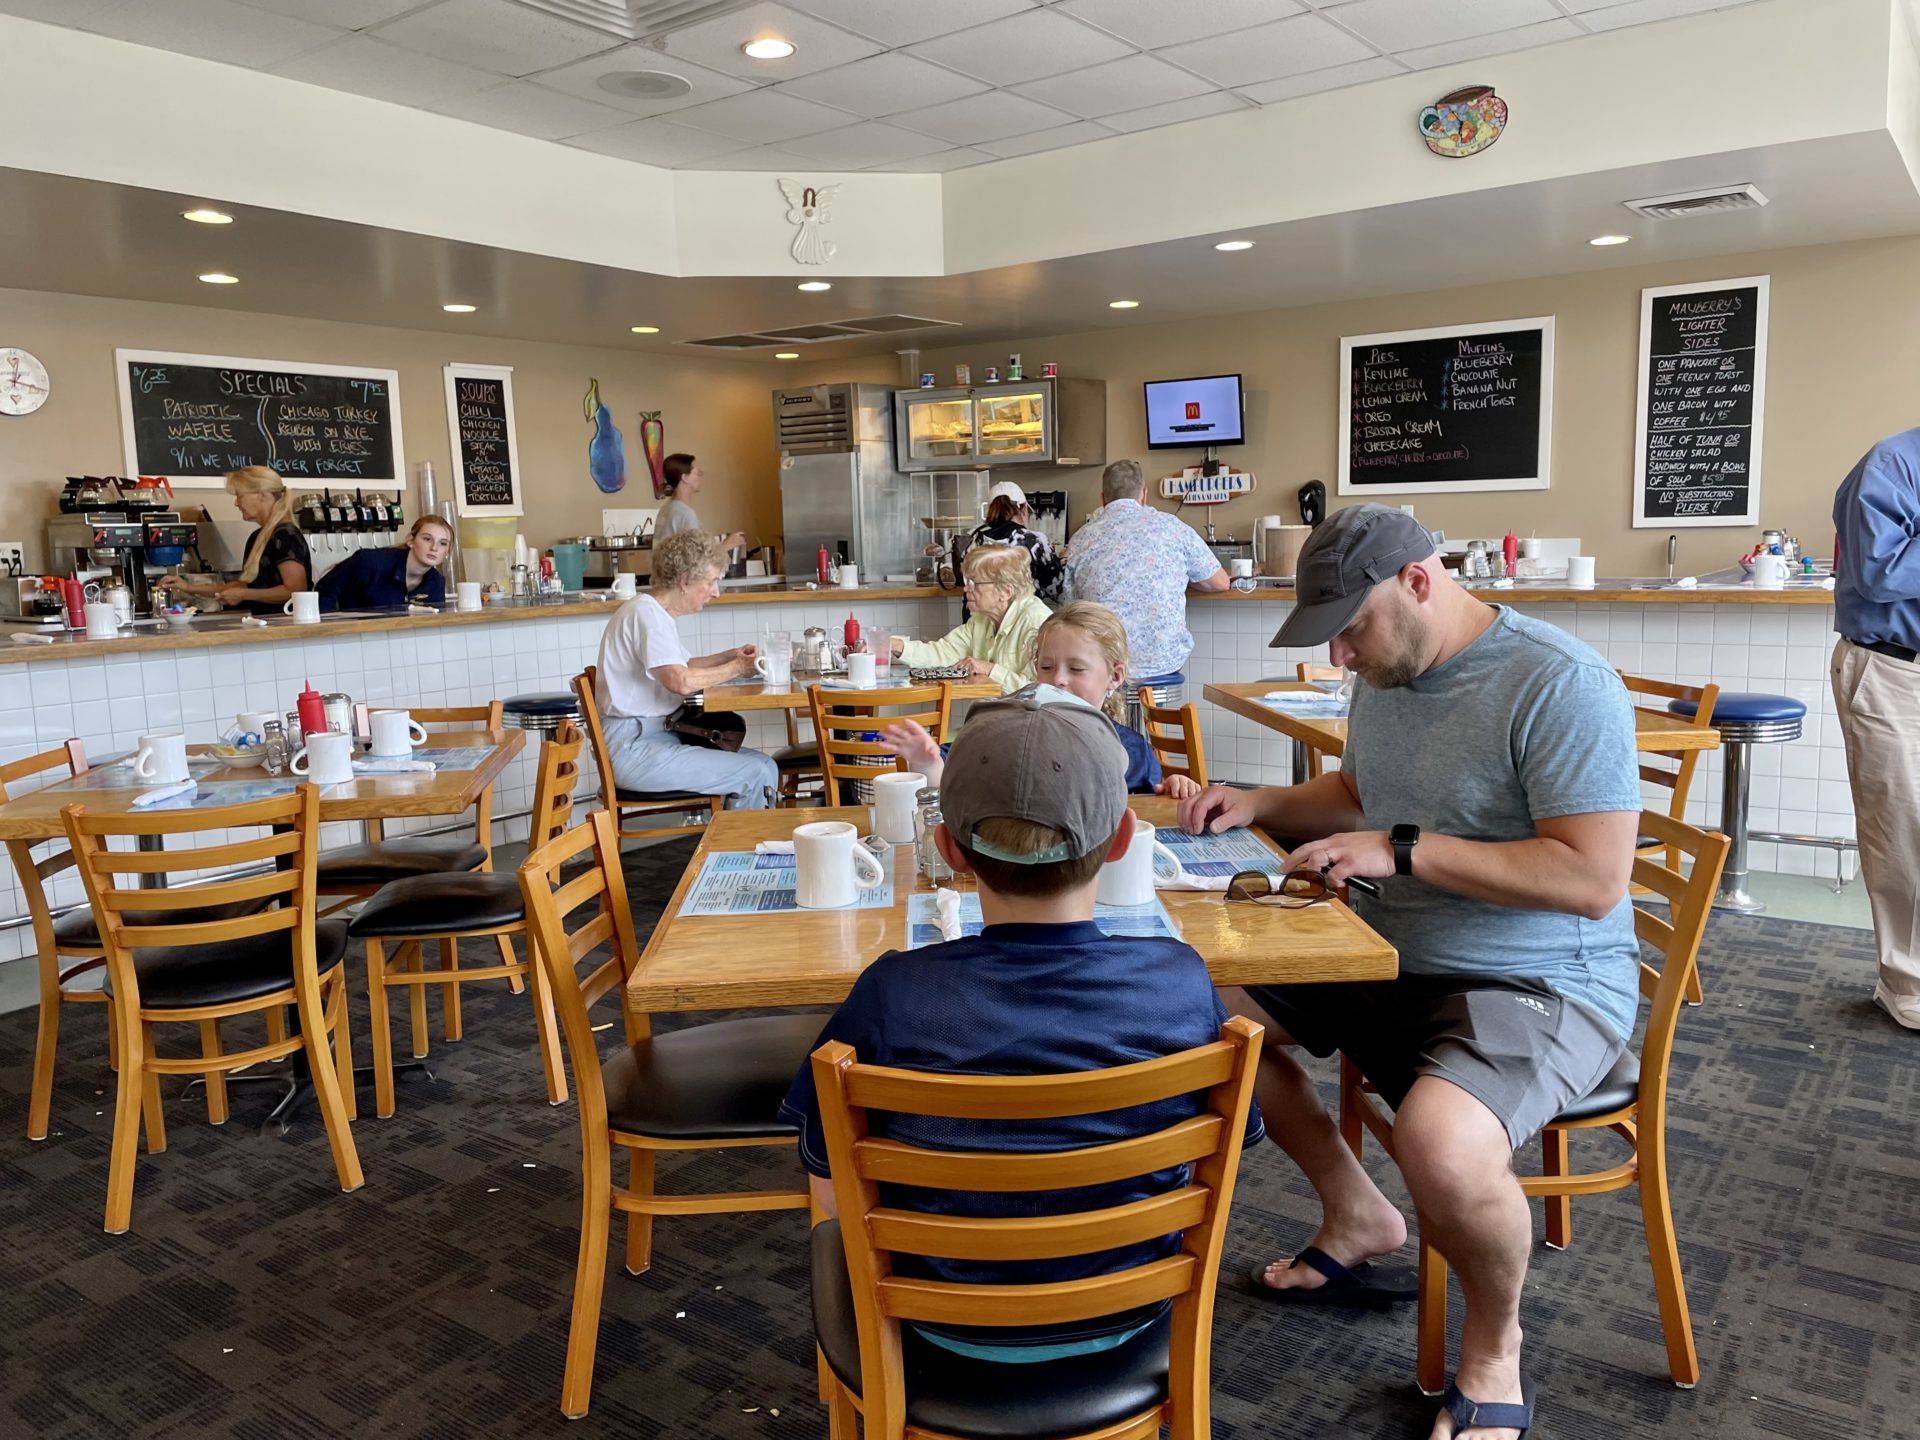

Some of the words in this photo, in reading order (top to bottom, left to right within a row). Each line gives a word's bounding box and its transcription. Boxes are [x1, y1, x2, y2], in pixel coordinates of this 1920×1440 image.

[1668, 296, 1742, 315] MAYBERRY'S
[1678, 317, 1728, 331] LIGHTER
[1458, 340, 1506, 356] MUFFINS
[1682, 336, 1720, 350] SIDES
[1371, 348, 1395, 364] PIES
[1452, 353, 1514, 371] BLUEBERRY
[1657, 360, 1678, 369] ONE
[1679, 357, 1720, 368] PANCAKE
[1721, 356, 1736, 367] OR
[1363, 367, 1409, 382] KEYLIME
[1450, 368, 1499, 383] CHOCOLATE
[1655, 374, 1675, 383] ONE
[1676, 372, 1711, 382] FRENCH
[1714, 370, 1744, 380] TOAST
[219, 369, 307, 395] SPECIALS
[1362, 379, 1424, 395] BLACKBERRY
[1451, 383, 1494, 397] BANANA
[1496, 377, 1518, 391] NUT
[461, 382, 497, 402] SOUPS
[1654, 387, 1682, 396] WITH
[1685, 386, 1705, 395] ONE
[1706, 385, 1726, 394] EGG
[1730, 383, 1751, 393] AND
[1362, 395, 1392, 408] LEMON
[1395, 391, 1428, 404] CREAM
[1453, 397, 1487, 411] FRENCH
[1486, 394, 1516, 407] TOAST
[1652, 401, 1676, 412] ONE
[1677, 400, 1708, 411] BACON
[1714, 399, 1737, 408] WITH
[163, 398, 240, 418] PATRIOTIC
[279, 404, 330, 419] CHICAGO
[333, 406, 379, 422] TURKEY
[460, 403, 491, 418] CHILI
[1364, 411, 1391, 423] OREO
[1653, 416, 1690, 426] COFFEE
[168, 422, 234, 439] WAFFLE
[277, 422, 316, 436] REUBEN
[324, 426, 338, 438] ON
[343, 425, 370, 440] RYE
[461, 419, 501, 430] CHICKEN
[1363, 425, 1401, 439] BOSTON
[1404, 419, 1443, 437] CREAM
[462, 429, 500, 440] NOODLE
[1650, 434, 1676, 446] HALF
[1678, 434, 1694, 445] OF
[1695, 434, 1723, 445] TUNA
[1725, 433, 1741, 444] OR
[293, 439, 322, 452] WITH
[330, 440, 368, 453] FRIES
[470, 442, 496, 452] STEAK
[1363, 438, 1423, 453] CHEESECAKE
[1650, 449, 1687, 459] CHICKEN
[1691, 447, 1721, 457] SALAD
[170, 446, 194, 469] 9/11
[201, 453, 221, 469] WE
[229, 455, 253, 469] WILL
[266, 457, 309, 473] NEVER
[315, 459, 367, 475] FORGET
[1649, 461, 1687, 472] SANDWICH
[1689, 462, 1711, 472] WITH
[1712, 462, 1720, 471] A
[1720, 461, 1747, 471] BOWL
[469, 464, 500, 475] POTATO
[477, 473, 505, 482] BACON
[1169, 475, 1243, 494] HAMBURGERS
[1649, 476, 1663, 486] OF
[1666, 474, 1692, 485] SOUP
[470, 483, 506, 492] CHICKEN
[467, 493, 511, 502] TORTILLA
[1658, 491, 1675, 502] NO
[1674, 502, 1710, 513] PLEASE
